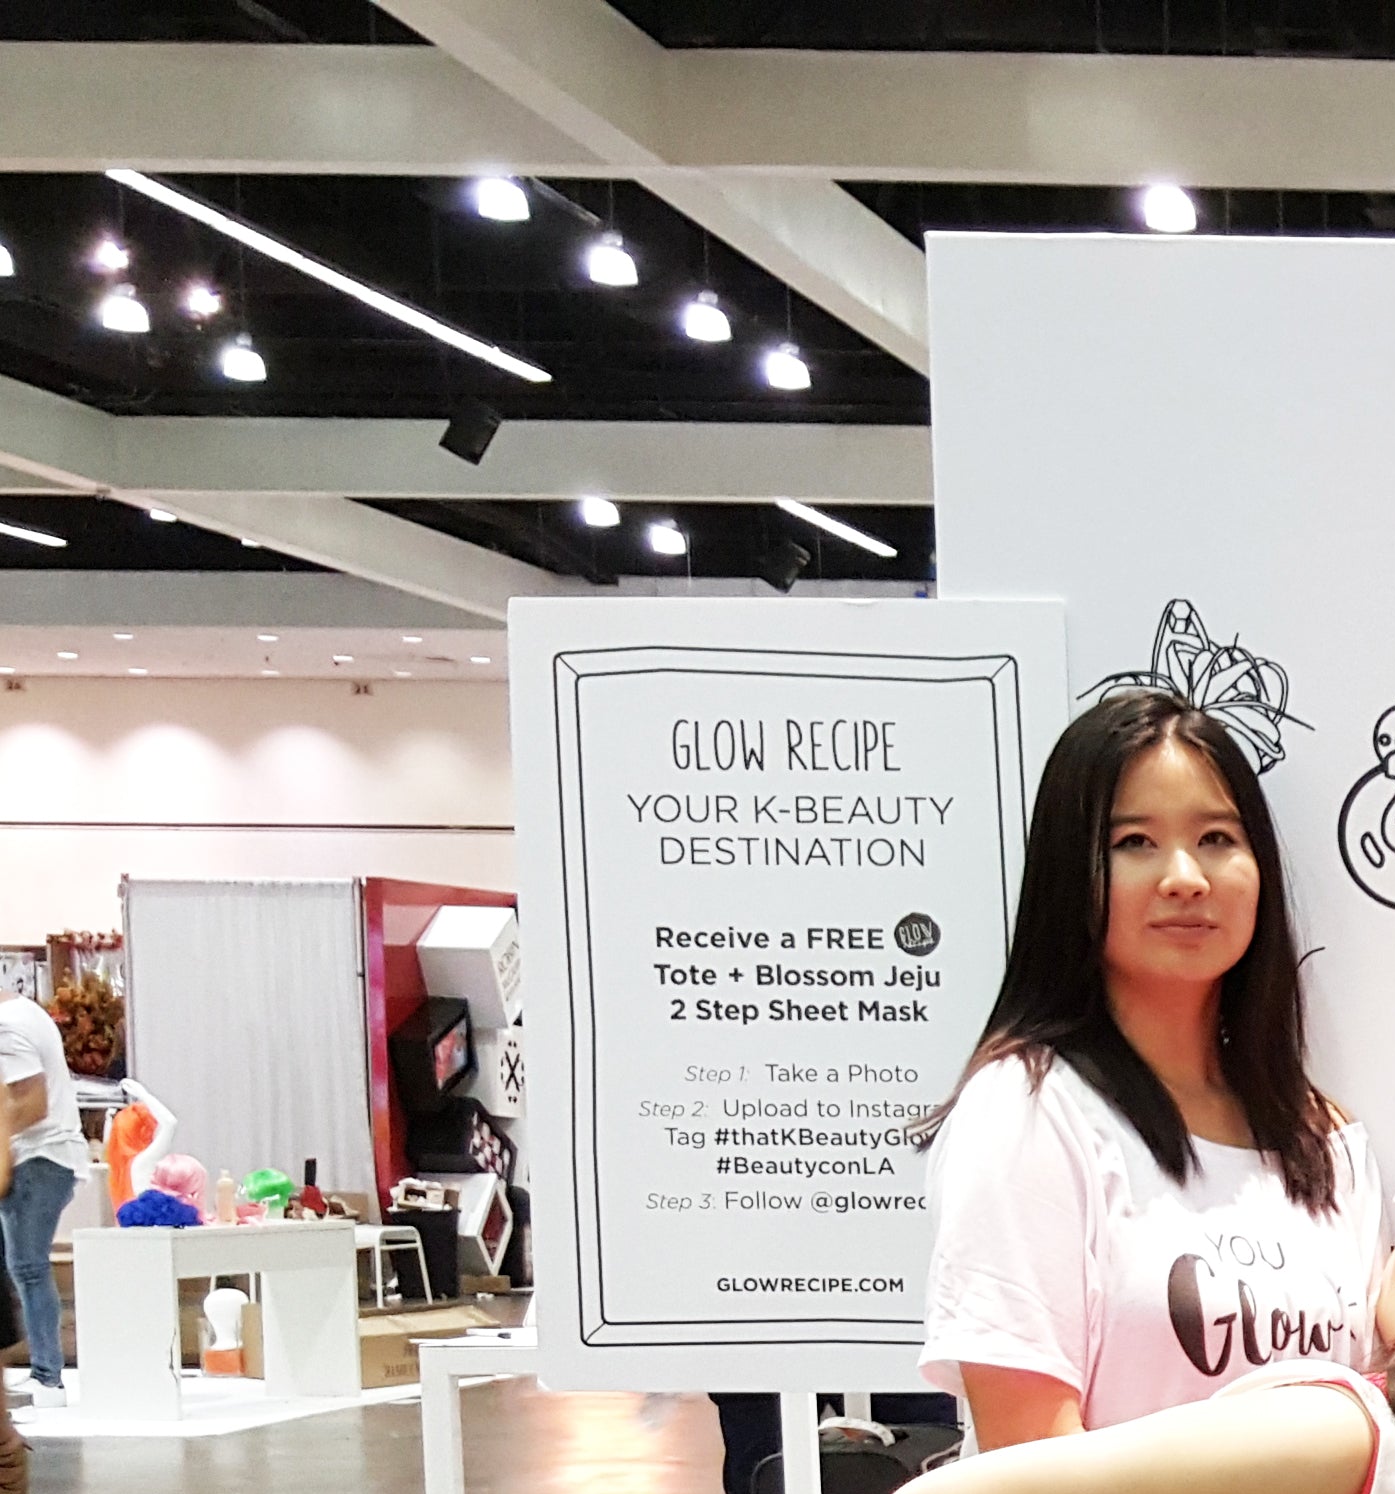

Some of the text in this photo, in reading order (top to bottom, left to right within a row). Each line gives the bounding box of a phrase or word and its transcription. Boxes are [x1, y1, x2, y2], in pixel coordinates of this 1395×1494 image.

[672, 718, 902, 772] GLOW RECIPE
[627, 793, 955, 826] YOUR K-BEAUTY
[660, 836, 925, 868] DESTINATION
[655, 926, 770, 950] Receive
[780, 931, 796, 950] a
[806, 927, 885, 950] FREE
[653, 963, 941, 992] Tote + Blossom Jeju
[670, 998, 930, 1026] 2 Step Sheet Mask
[685, 1062, 919, 1084] Step 1: Take a Photo
[638, 1098, 941, 1121] Step 2: Upload to Instagr
[664, 1126, 930, 1151] Tag #thatKBeautyGlo
[716, 1156, 896, 1179] #BeautyconLA
[645, 1192, 693, 1212] Step
[698, 1193, 716, 1210] 3:
[725, 1190, 803, 1210] Follow
[1204, 1232, 1286, 1270] YOU
[716, 1277, 904, 1293] GLOWRECIPE.COM
[1166, 1252, 1344, 1377] Glow
